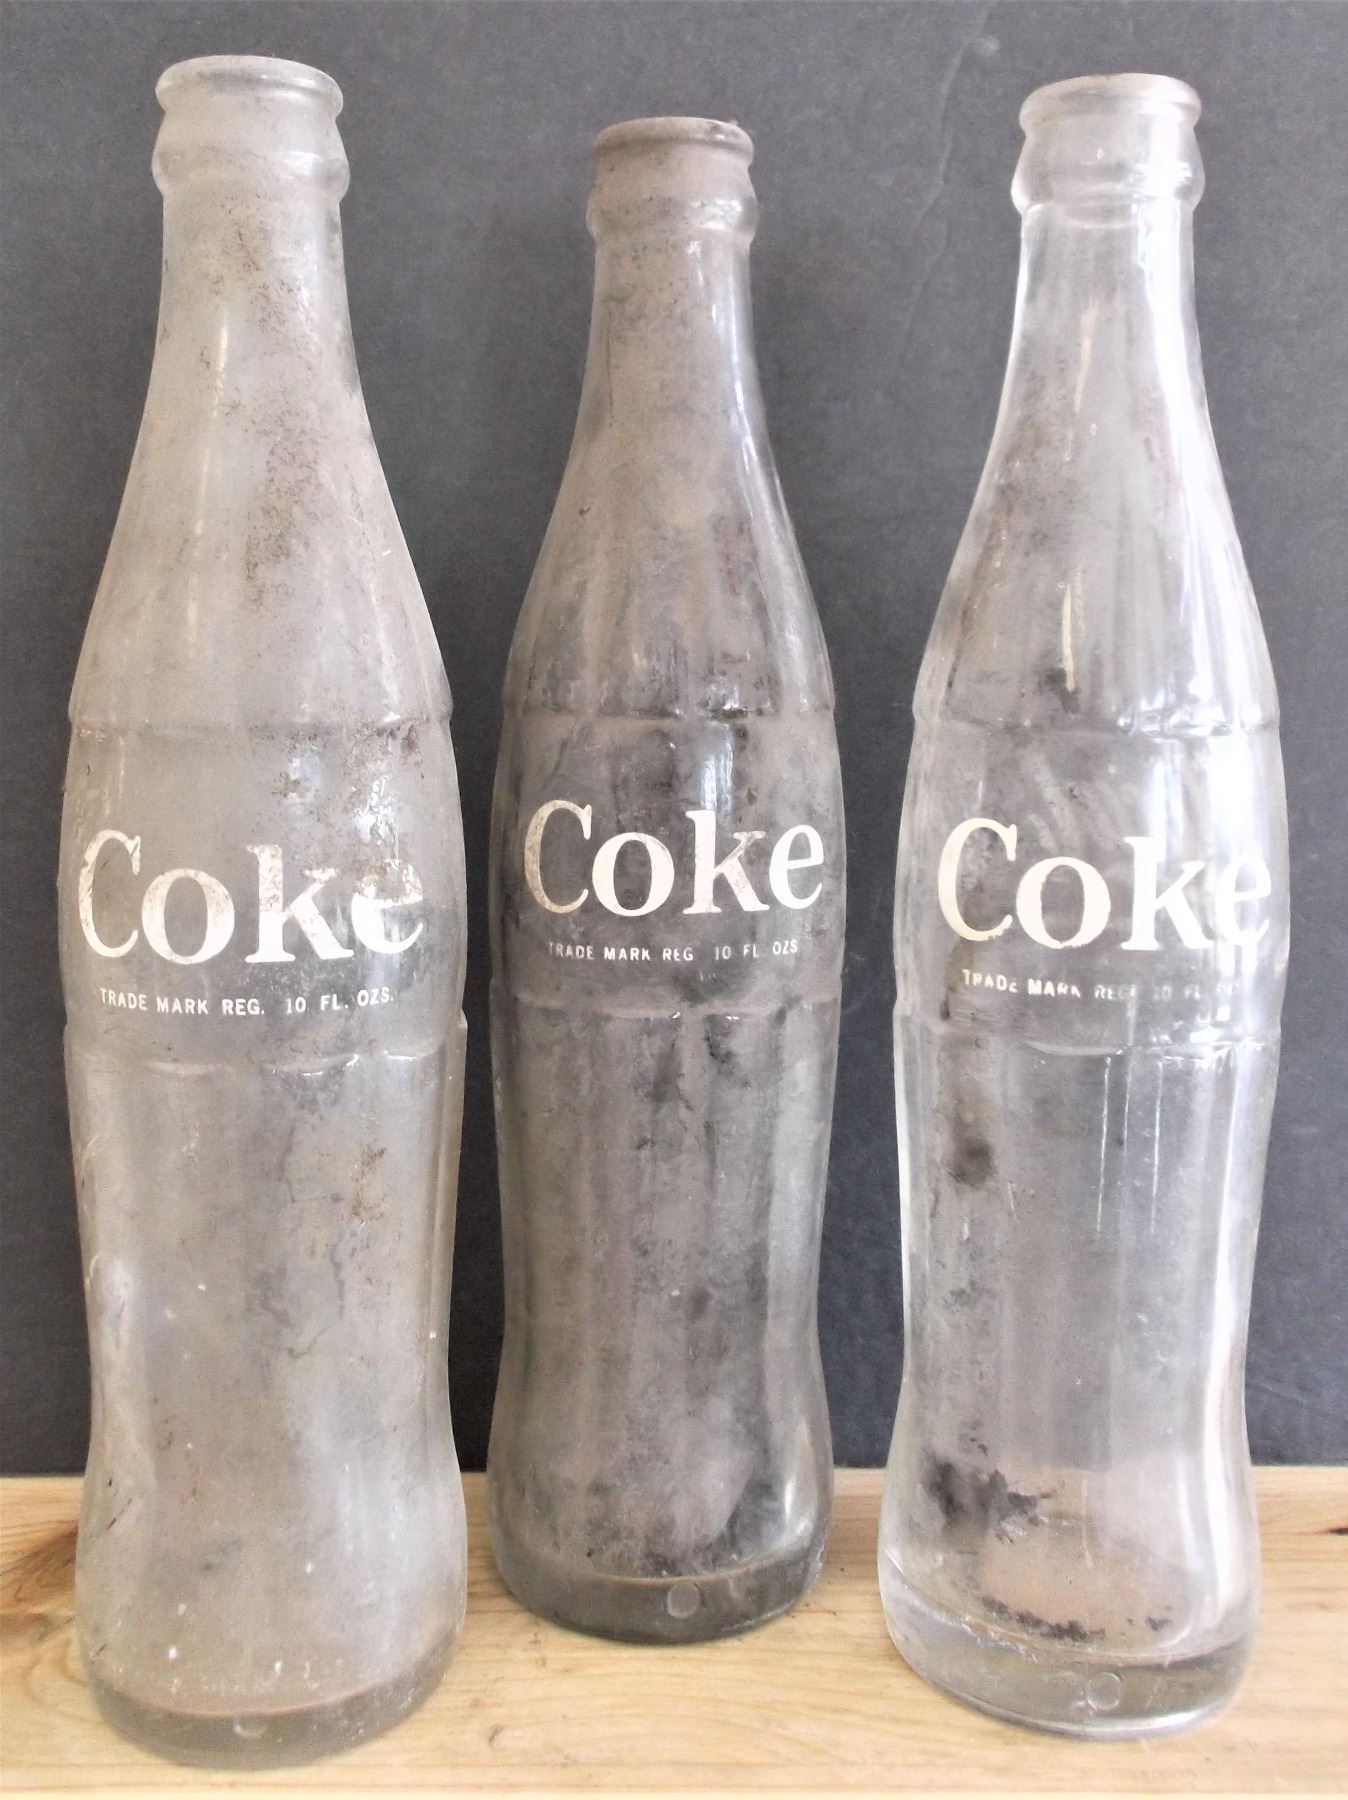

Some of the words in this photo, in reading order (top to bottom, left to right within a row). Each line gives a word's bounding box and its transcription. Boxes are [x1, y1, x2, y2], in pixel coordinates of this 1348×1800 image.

[78, 829, 424, 965] Coke
[524, 799, 825, 917] Coke
[938, 817, 1272, 949] Coke
[100, 987, 148, 1011] TRADE
[156, 996, 208, 1015] MARK
[222, 998, 265, 1016] REG.
[286, 996, 307, 1014] 10
[320, 993, 349, 1011] FL.
[357, 986, 394, 1007] OZS.
[548, 941, 594, 960] TRADE
[603, 946, 651, 961] MARK
[662, 946, 694, 961] REG
[714, 945, 731, 960] 10
[743, 943, 760, 958] FL
[772, 938, 799, 956] OZS
